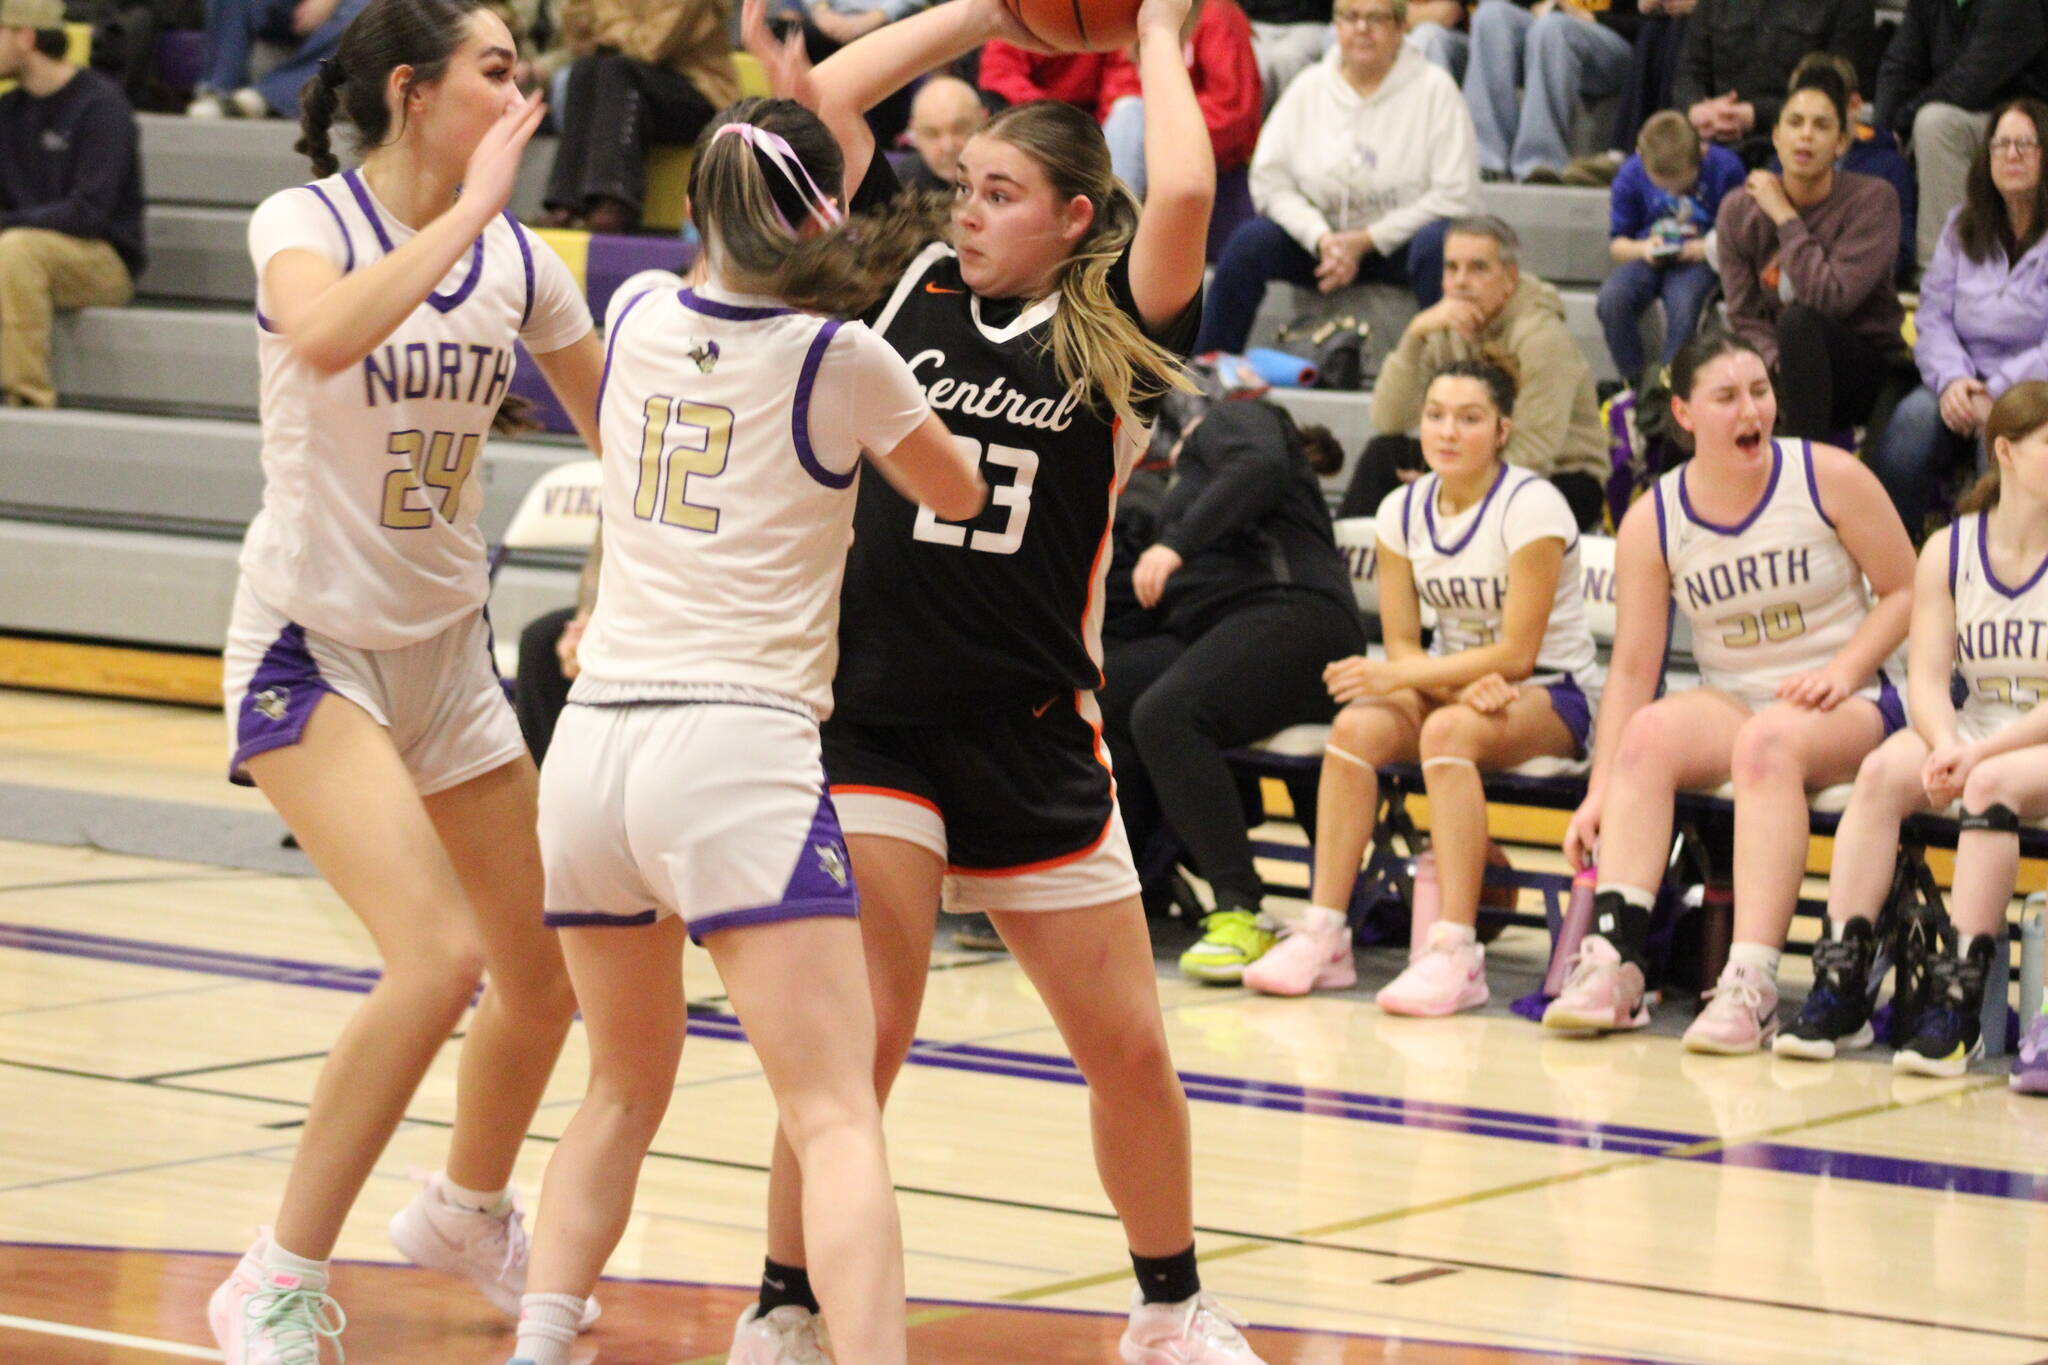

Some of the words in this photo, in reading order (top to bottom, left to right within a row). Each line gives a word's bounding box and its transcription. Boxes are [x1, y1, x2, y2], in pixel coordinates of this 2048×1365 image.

[364, 342, 512, 408] NORTH
[906, 349, 1086, 432] Central
[380, 429, 480, 530] 24
[634, 394, 735, 534] 12
[912, 434, 1040, 555] 23
[1684, 547, 1811, 610] NORTH
[1957, 618, 2048, 662] NORT
